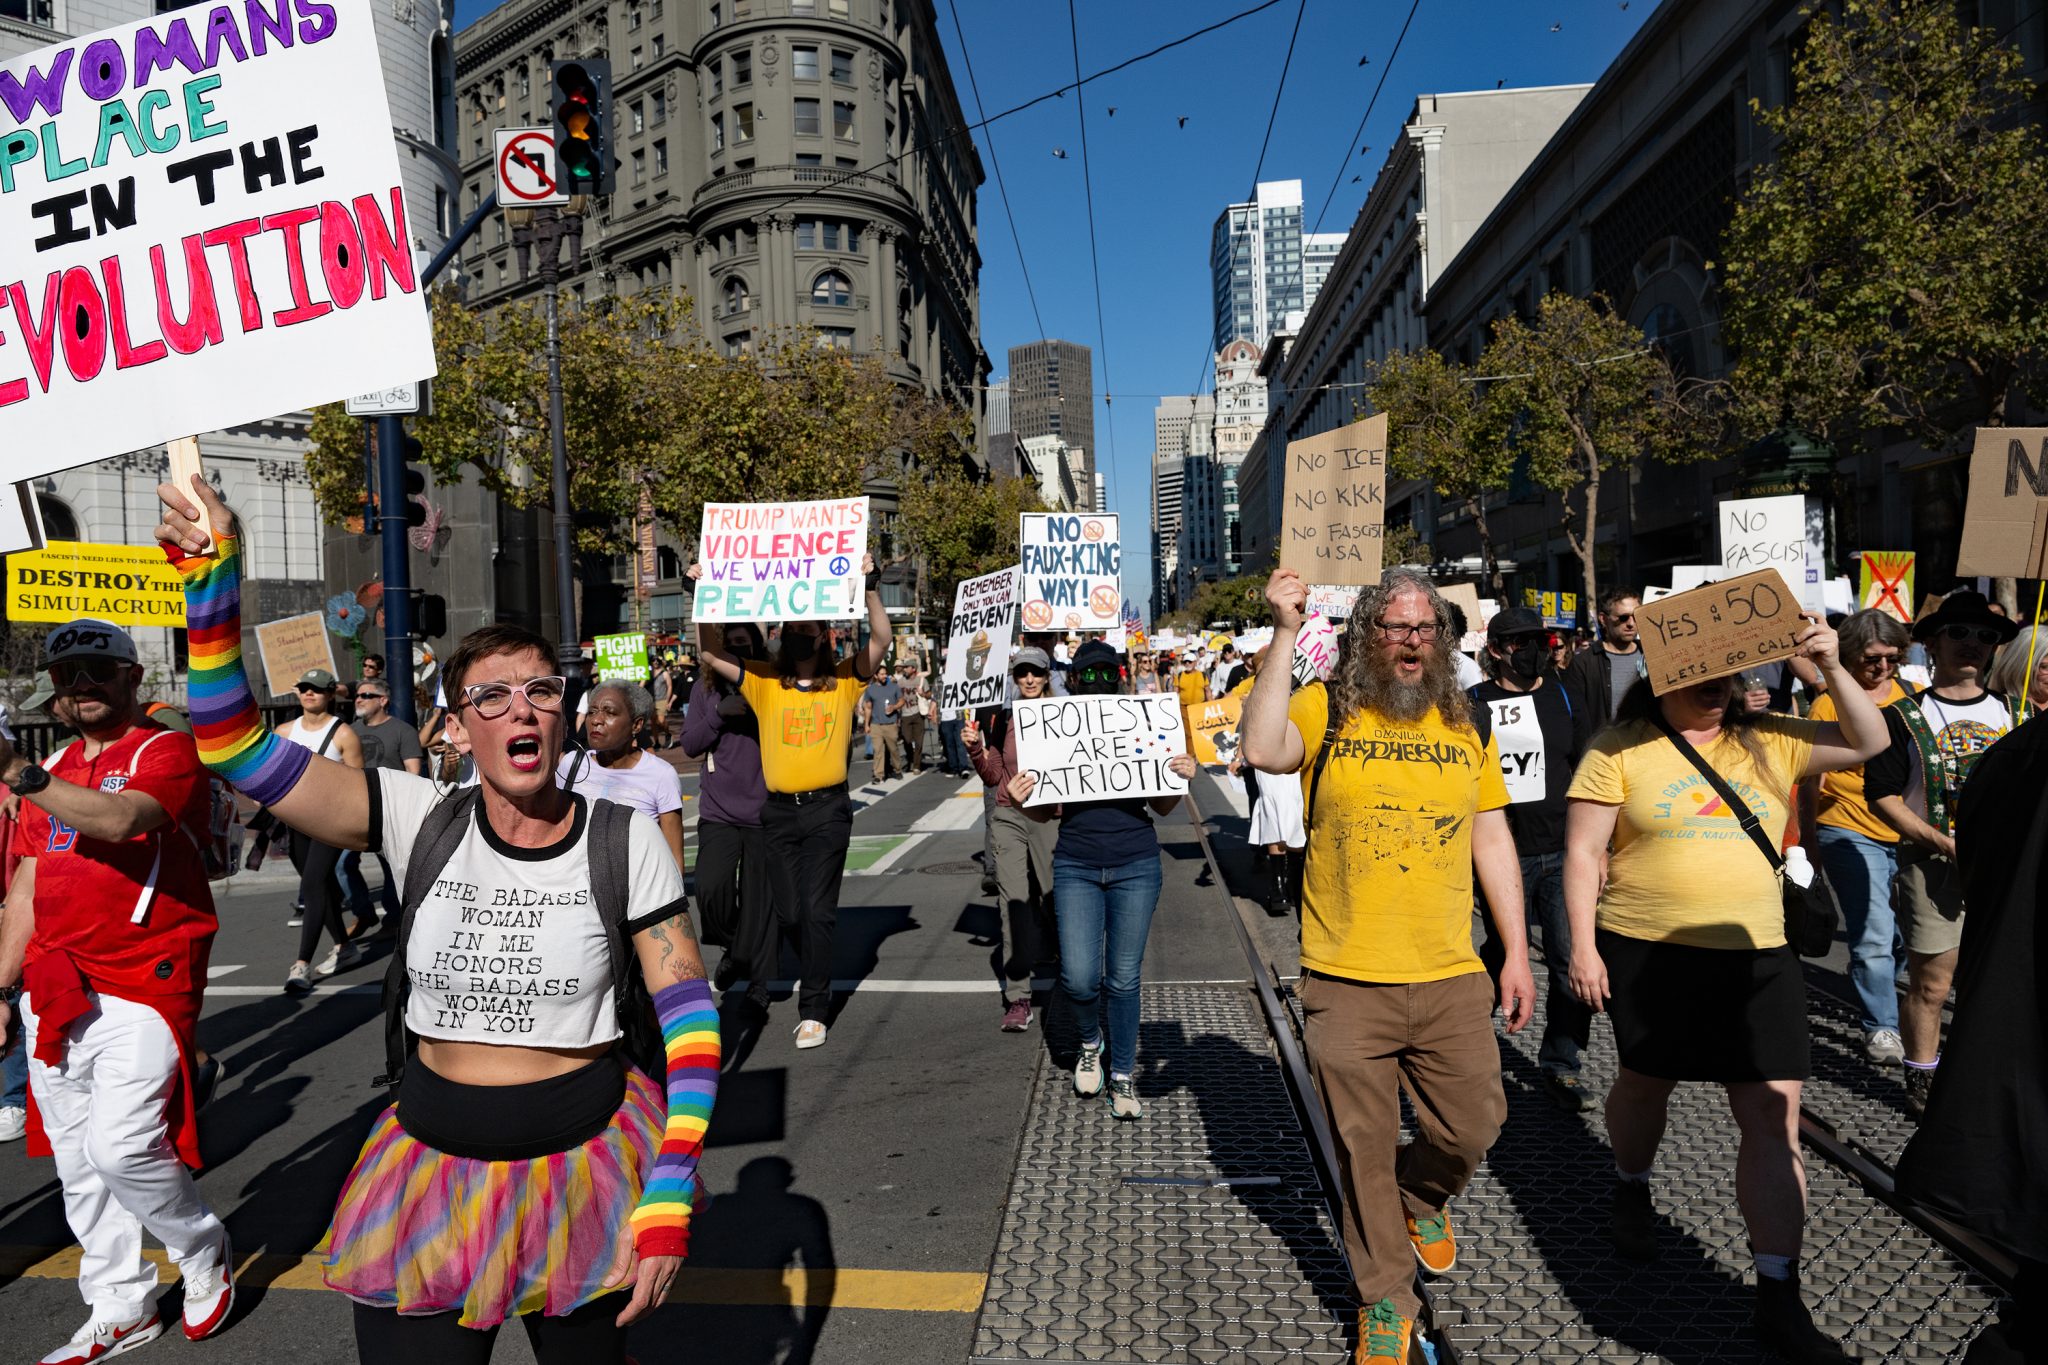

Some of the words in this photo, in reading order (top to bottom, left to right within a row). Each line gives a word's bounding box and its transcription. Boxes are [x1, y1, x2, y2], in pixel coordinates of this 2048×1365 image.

[0, 0, 337, 125] WOMANS
[0, 74, 229, 194] PLACE
[31, 176, 137, 253] IN
[166, 124, 325, 206] THE
[1296, 453, 1327, 473] NO
[1333, 447, 1384, 471] ICE
[1295, 489, 1327, 512] NO
[1335, 482, 1383, 508] KKK
[707, 507, 785, 531] TRUMP
[790, 502, 864, 530] WANTS
[1047, 516, 1082, 543] NO
[1729, 508, 1768, 535] NO
[705, 529, 856, 560] VIOLENCE
[1291, 526, 1317, 541] NO
[1327, 522, 1385, 542] FASCIST
[1022, 542, 1121, 577] FAUX-KING
[1315, 543, 1363, 562] USA
[1725, 539, 1806, 569] FASCIST
[17, 568, 151, 591] DESTROY
[150, 581, 184, 592] THE
[710, 561, 744, 582] WE
[752, 558, 816, 581] WANT
[962, 571, 1013, 600] REMEMBER
[1038, 578, 1089, 607] WAY!
[17, 593, 184, 616] SIMULACRUM
[963, 600, 980, 612] ONLY
[982, 595, 995, 606] YOU
[995, 588, 1012, 603] CAN
[951, 601, 1014, 638] PREVENT
[1646, 612, 1699, 647] YES
[1725, 582, 1782, 626] 50
[595, 634, 645, 657] FIGHT
[600, 665, 647, 682] POWER
[607, 653, 635, 668] THE
[1665, 661, 1708, 686] LETS
[1726, 650, 1747, 666] GO
[942, 673, 1005, 709] FASCISM
[1018, 697, 1179, 742] PROTESTS
[1203, 703, 1225, 721] ALL
[1498, 704, 1522, 727] IS
[1374, 729, 1428, 742] OMNIUM
[1068, 736, 1130, 763] ARE
[1662, 773, 1709, 799] GRAND
[1653, 802, 1673, 819] LA
[1659, 829, 1697, 840] CLUB
[434, 879, 479, 902] THE
[491, 888, 588, 907] BADASS
[461, 906, 545, 928] WOMAN
[448, 931, 485, 951] IN
[498, 934, 535, 952] ME
[432, 951, 543, 975] HONORS
[408, 967, 450, 990] THE
[469, 976, 580, 997] BADASS
[444, 994, 534, 1016] WOMAN
[434, 1009, 468, 1029] IN
[483, 1014, 536, 1033] YOU
